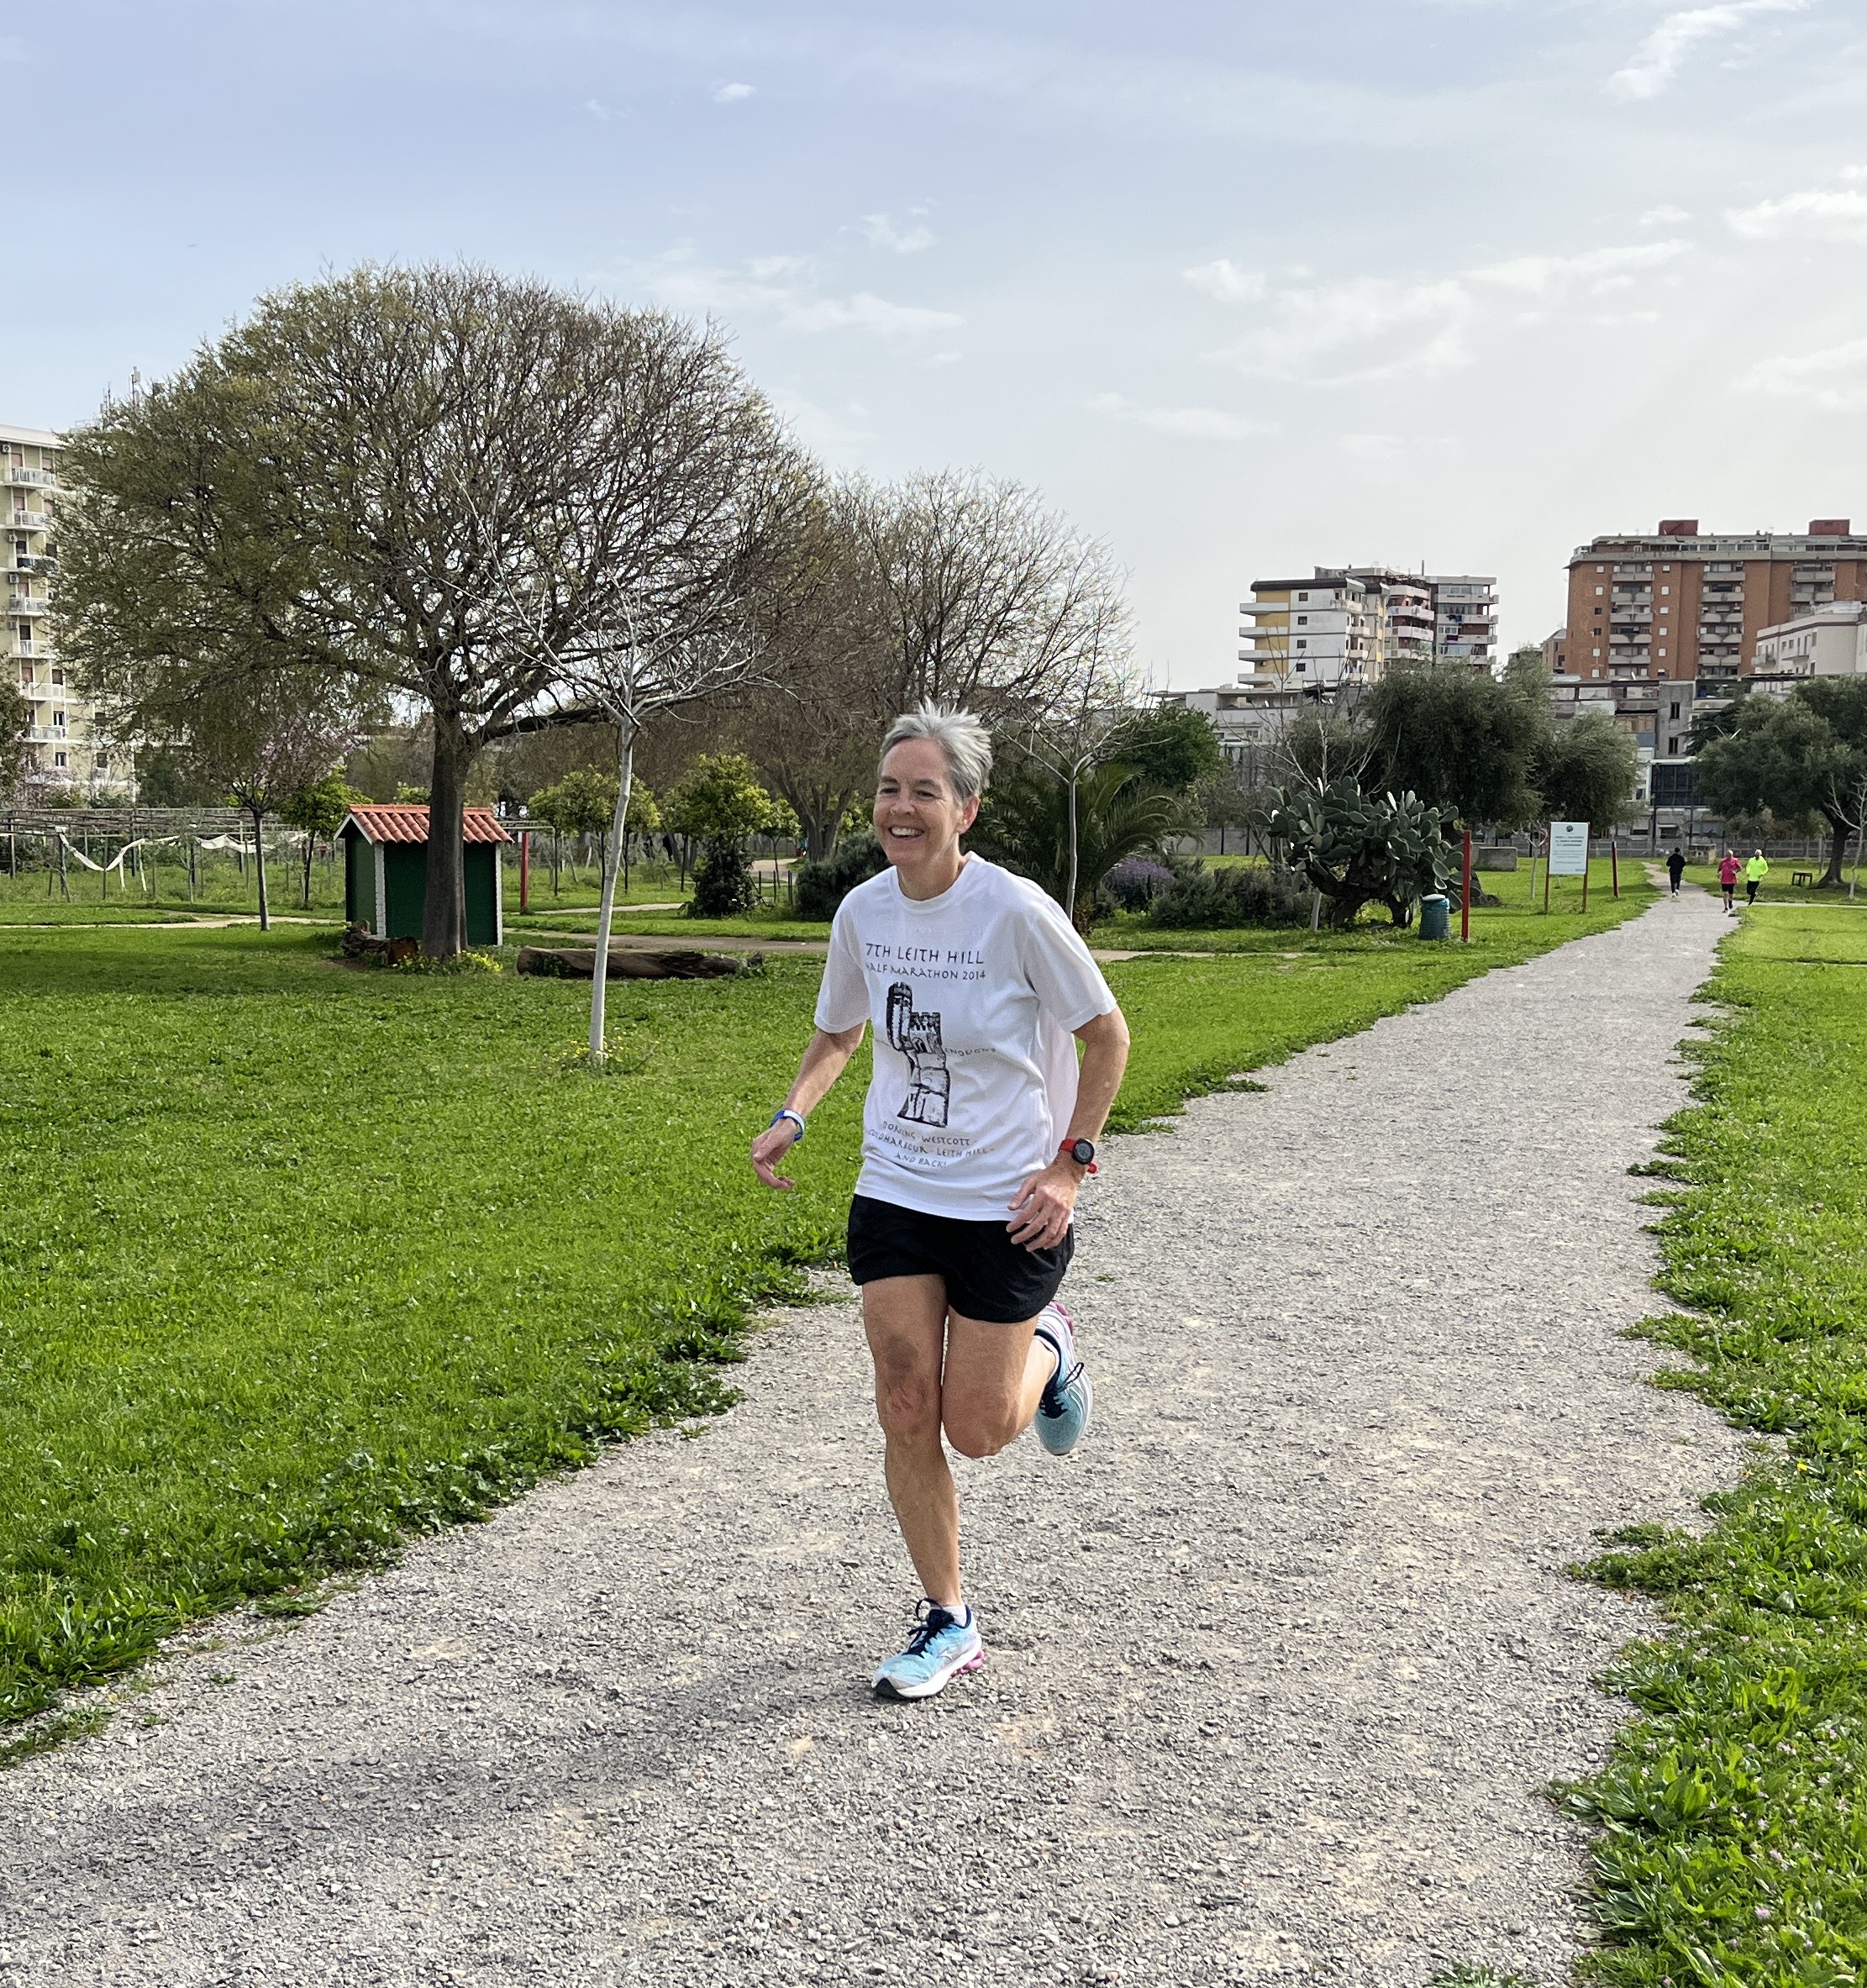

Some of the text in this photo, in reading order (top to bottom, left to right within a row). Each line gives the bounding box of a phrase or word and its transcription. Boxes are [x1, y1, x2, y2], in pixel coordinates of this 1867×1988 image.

[865, 943, 984, 965] 7TH LEITH HILL
[891, 965, 958, 980] MARATHON
[962, 970, 986, 981] 2014
[922, 1135, 970, 1146] WESTCOTT
[894, 1152, 947, 1168] AND BACK!
[937, 1147, 962, 1158] LEITH
